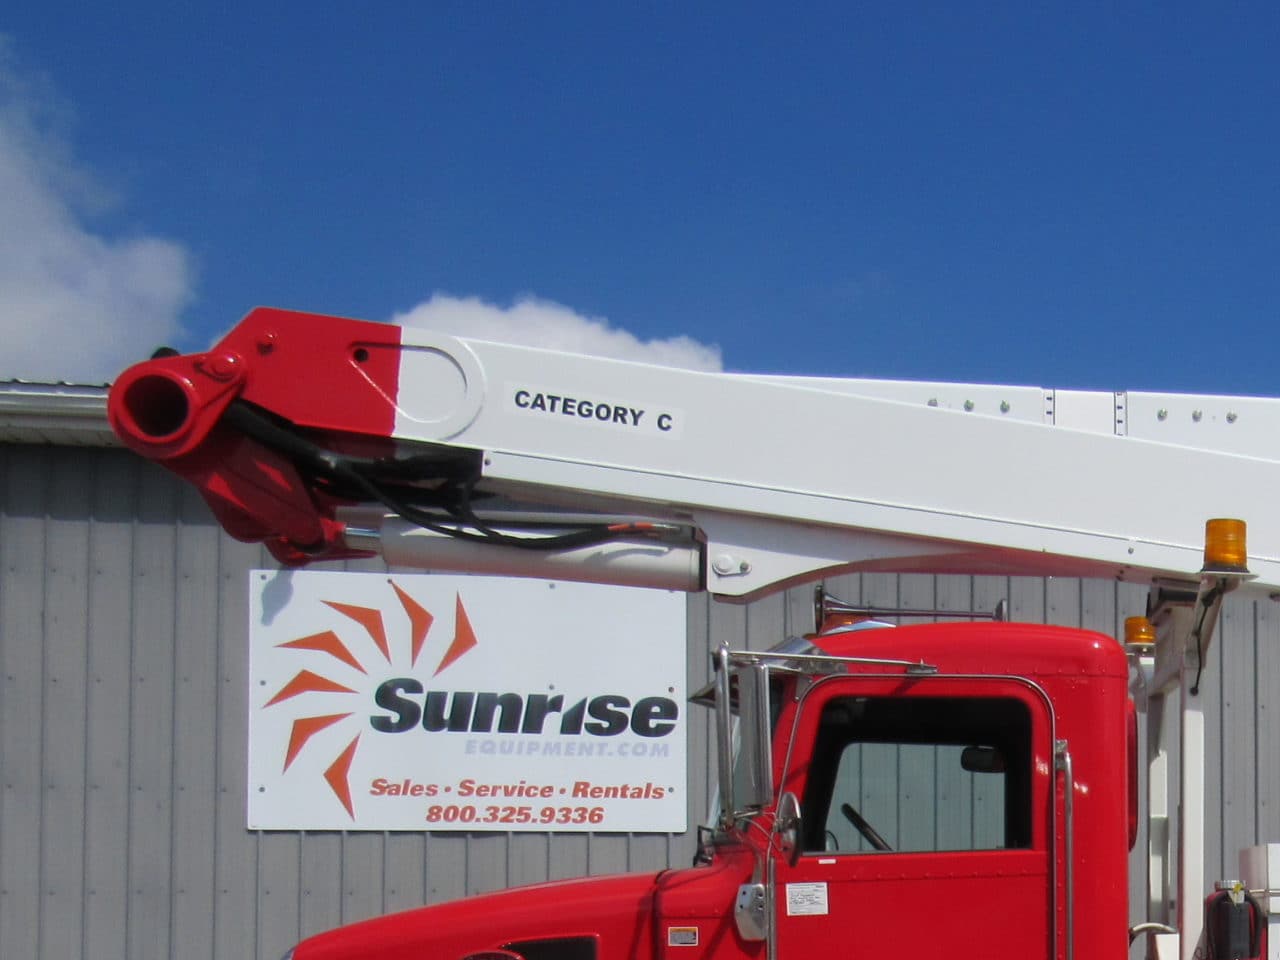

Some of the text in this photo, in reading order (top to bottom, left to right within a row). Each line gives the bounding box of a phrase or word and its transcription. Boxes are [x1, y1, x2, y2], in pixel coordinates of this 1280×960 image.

[514, 390, 673, 432] CATEGORY C
[370, 677, 679, 738] Sunrise
[464, 739, 670, 757] EQUIPMENT.COM
[370, 778, 665, 799] Sales Service Rentals
[426, 805, 605, 824] 800.325.9336
